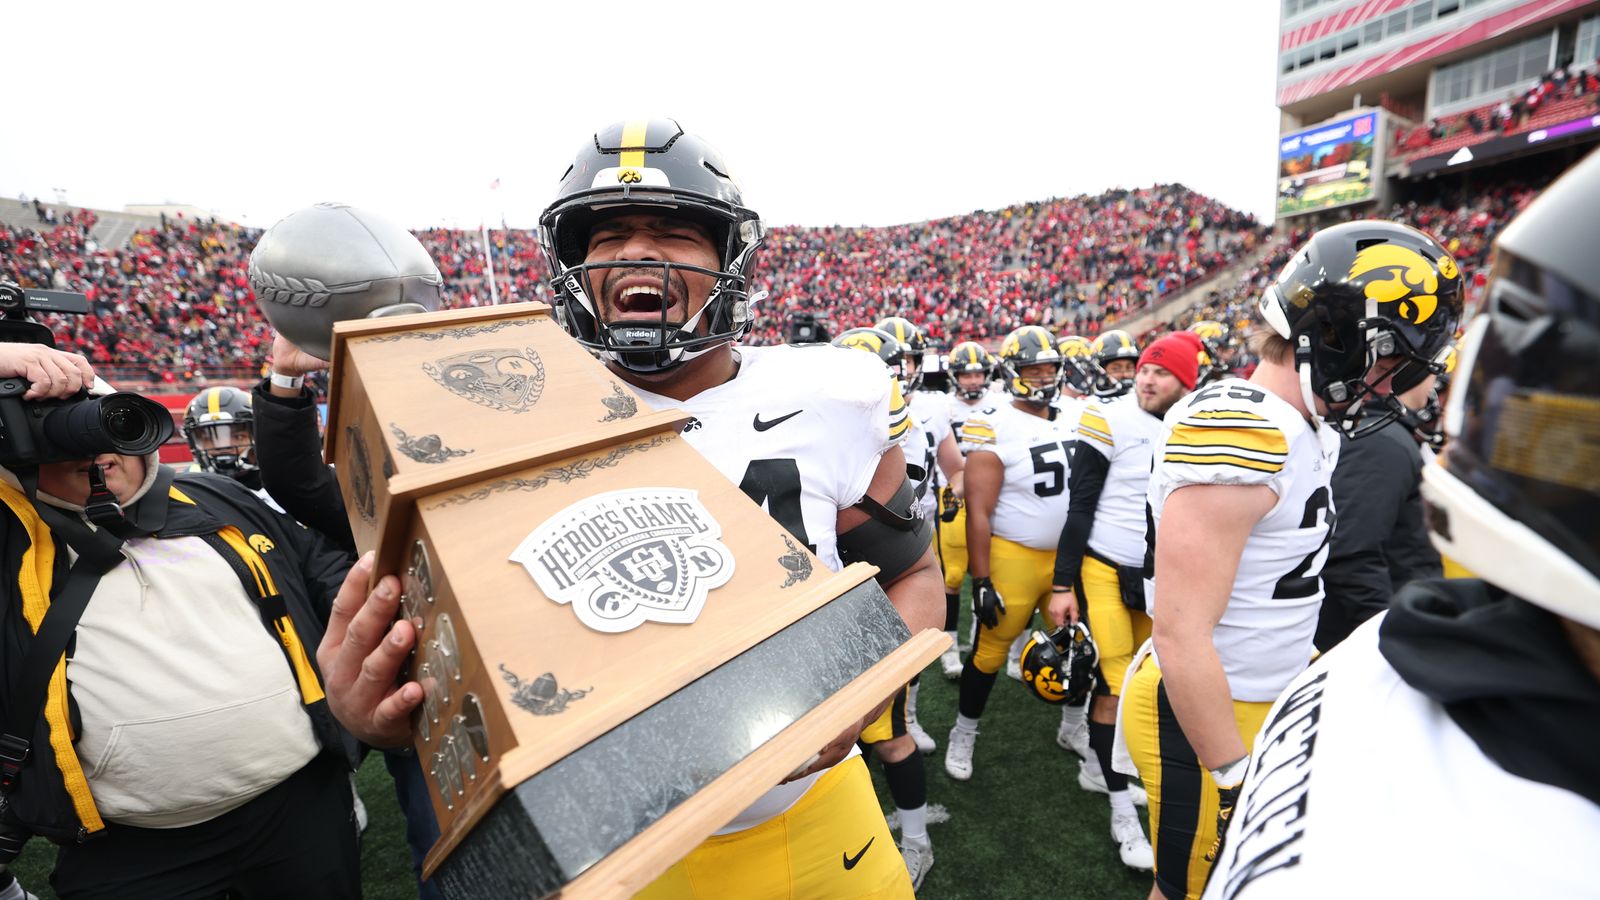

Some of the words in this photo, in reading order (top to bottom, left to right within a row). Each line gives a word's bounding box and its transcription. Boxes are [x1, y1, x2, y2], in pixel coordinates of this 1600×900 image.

[626, 330, 656, 338] Riddell
[537, 510, 629, 591] HEROES
[623, 501, 709, 534] GAME
[690, 550, 717, 572] N
